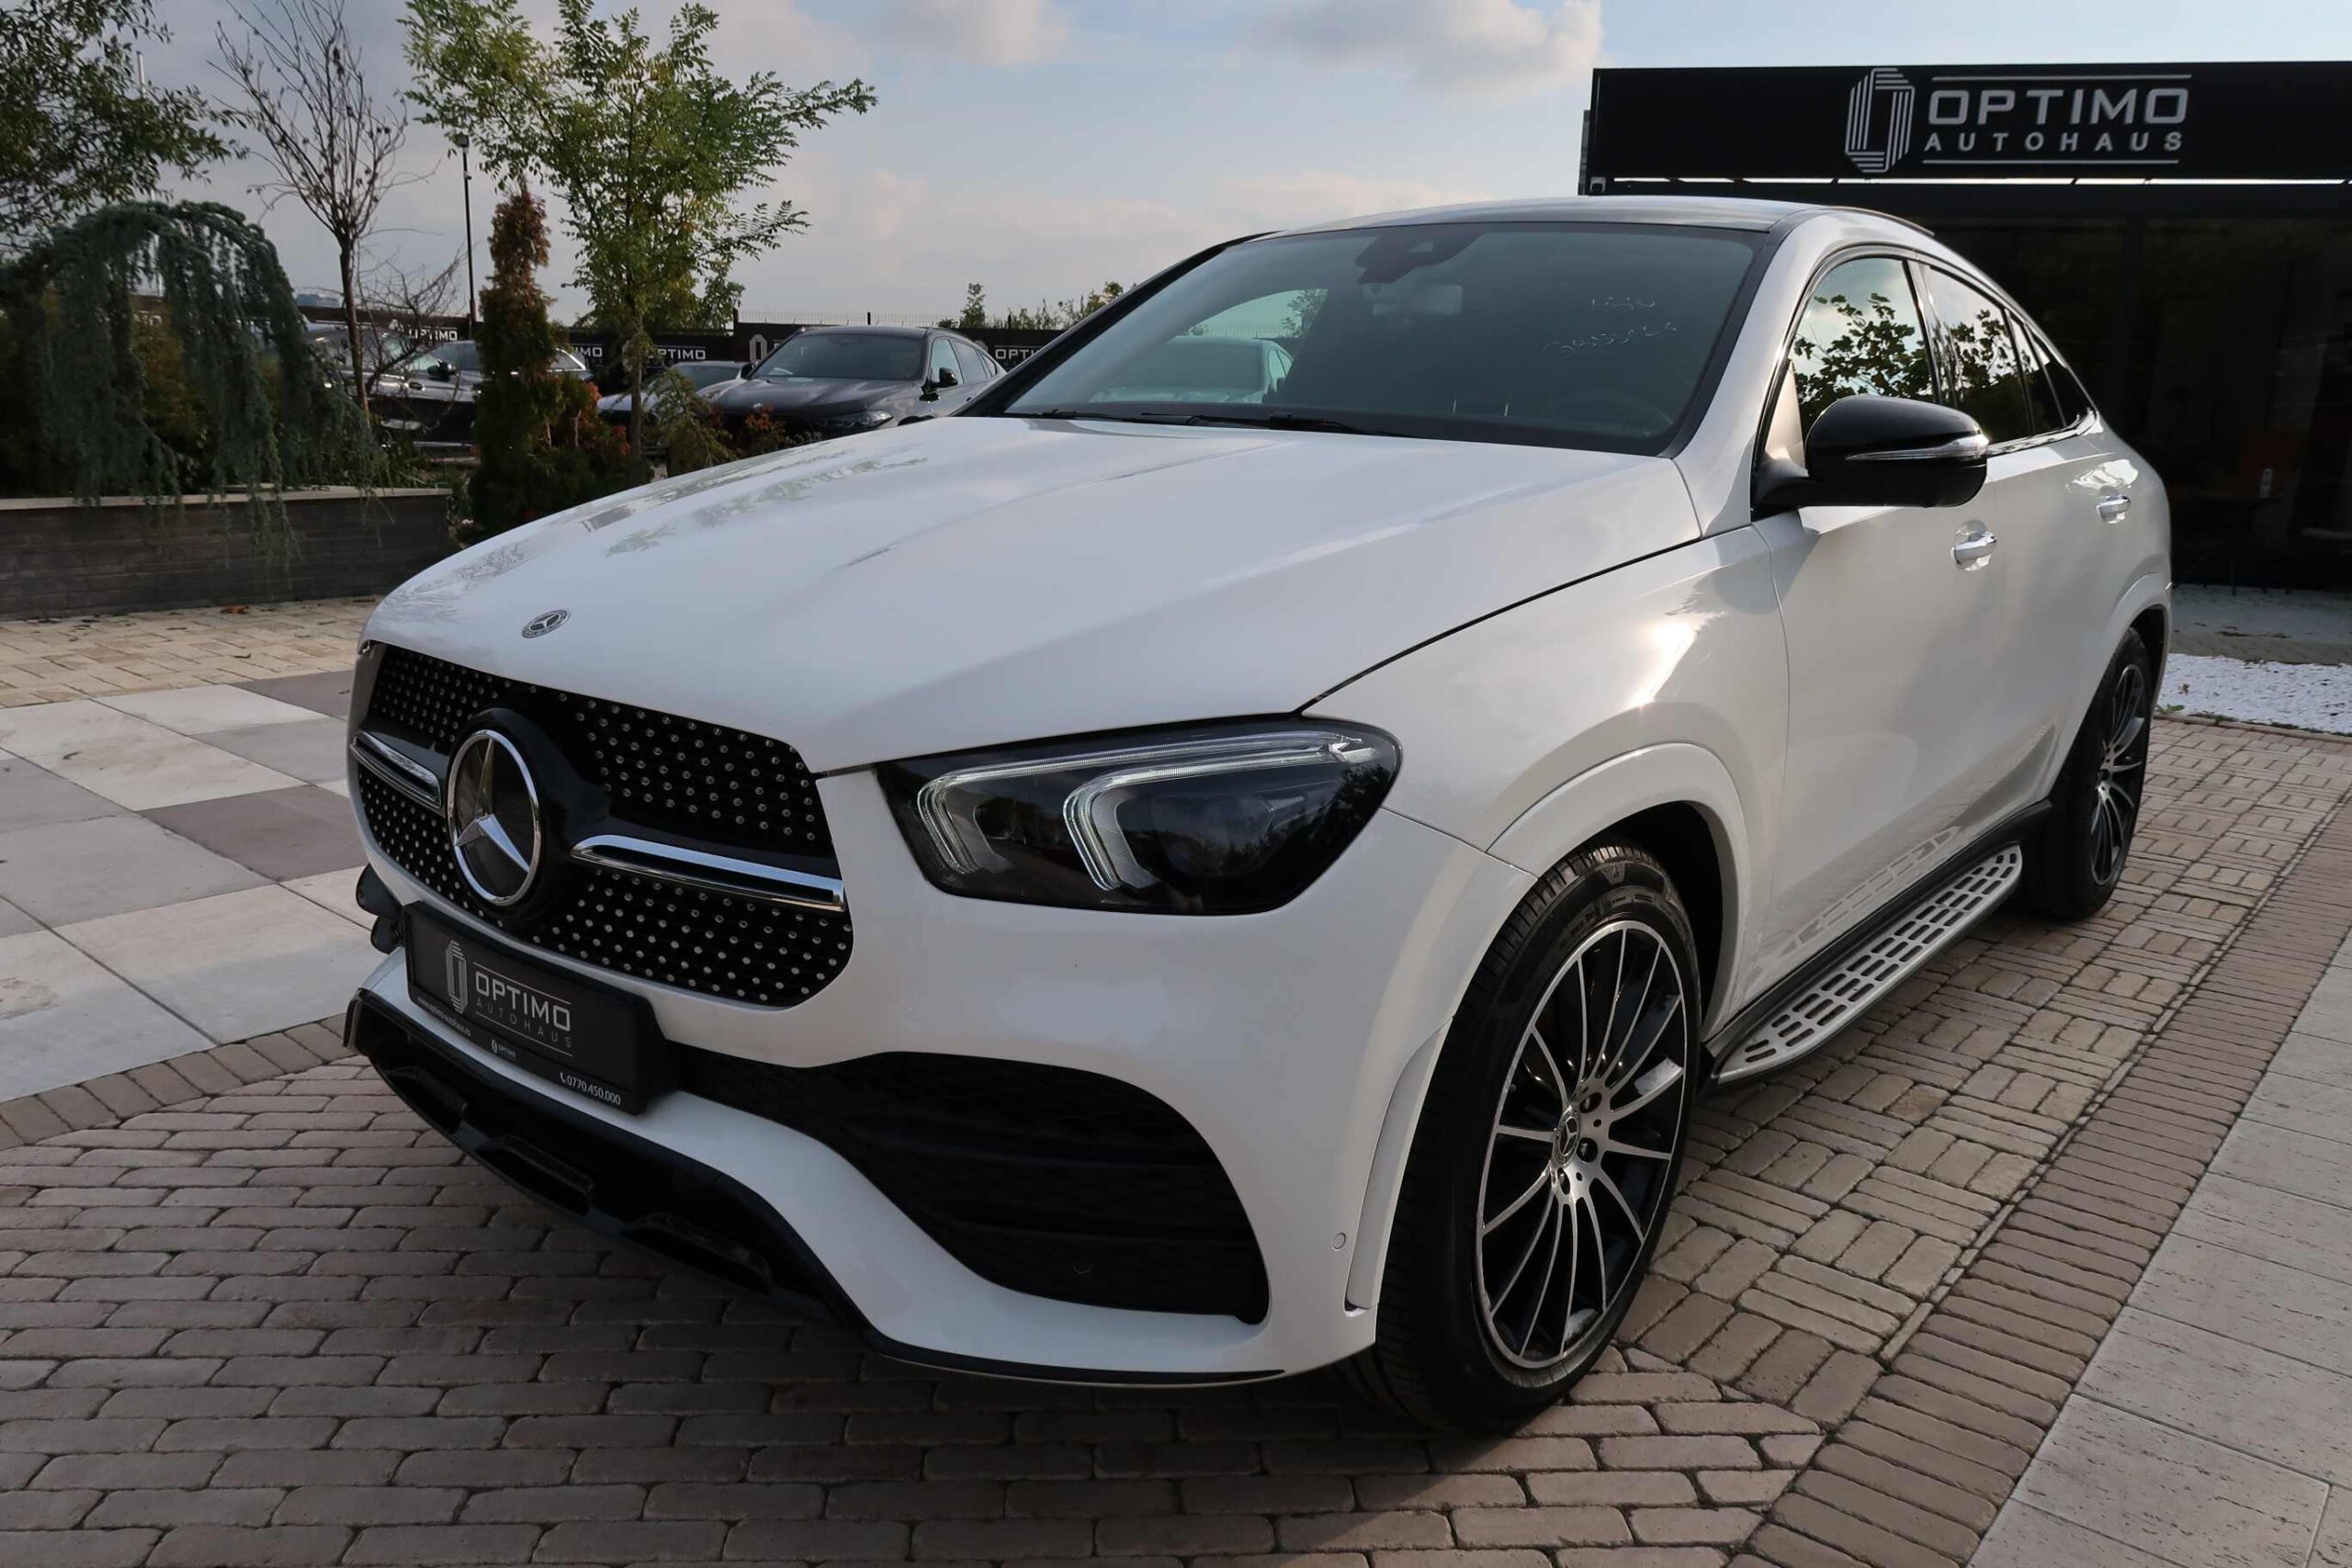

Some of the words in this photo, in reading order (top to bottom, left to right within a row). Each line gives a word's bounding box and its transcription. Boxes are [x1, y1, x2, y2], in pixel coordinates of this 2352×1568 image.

[1928, 88, 2189, 126] OPTIMO
[1924, 131, 2183, 152] AUTOHAUS
[647, 347, 707, 360] PTIMO
[476, 971, 571, 1032] OPTIMO
[476, 998, 571, 1048] AUTOHAUS
